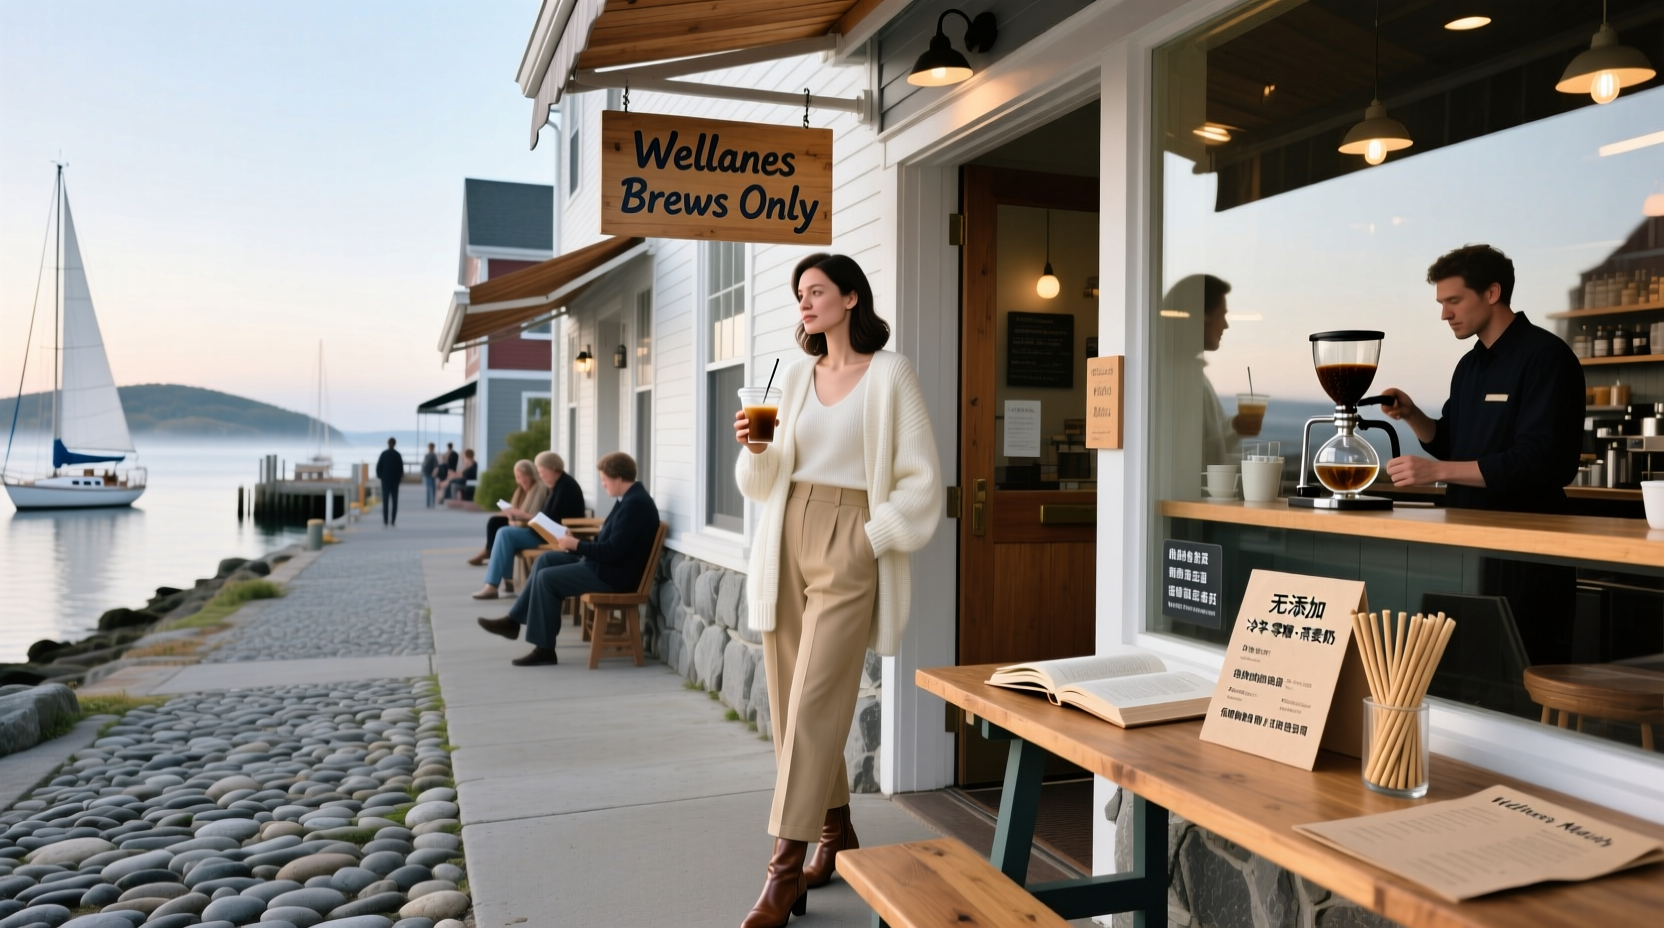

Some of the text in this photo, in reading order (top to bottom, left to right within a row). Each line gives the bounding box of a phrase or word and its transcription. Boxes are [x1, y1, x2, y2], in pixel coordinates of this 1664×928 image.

[634, 130, 796, 177] Wellanes
[621, 177, 819, 234] Brews Only
[1268, 593, 1327, 620] 无添加
